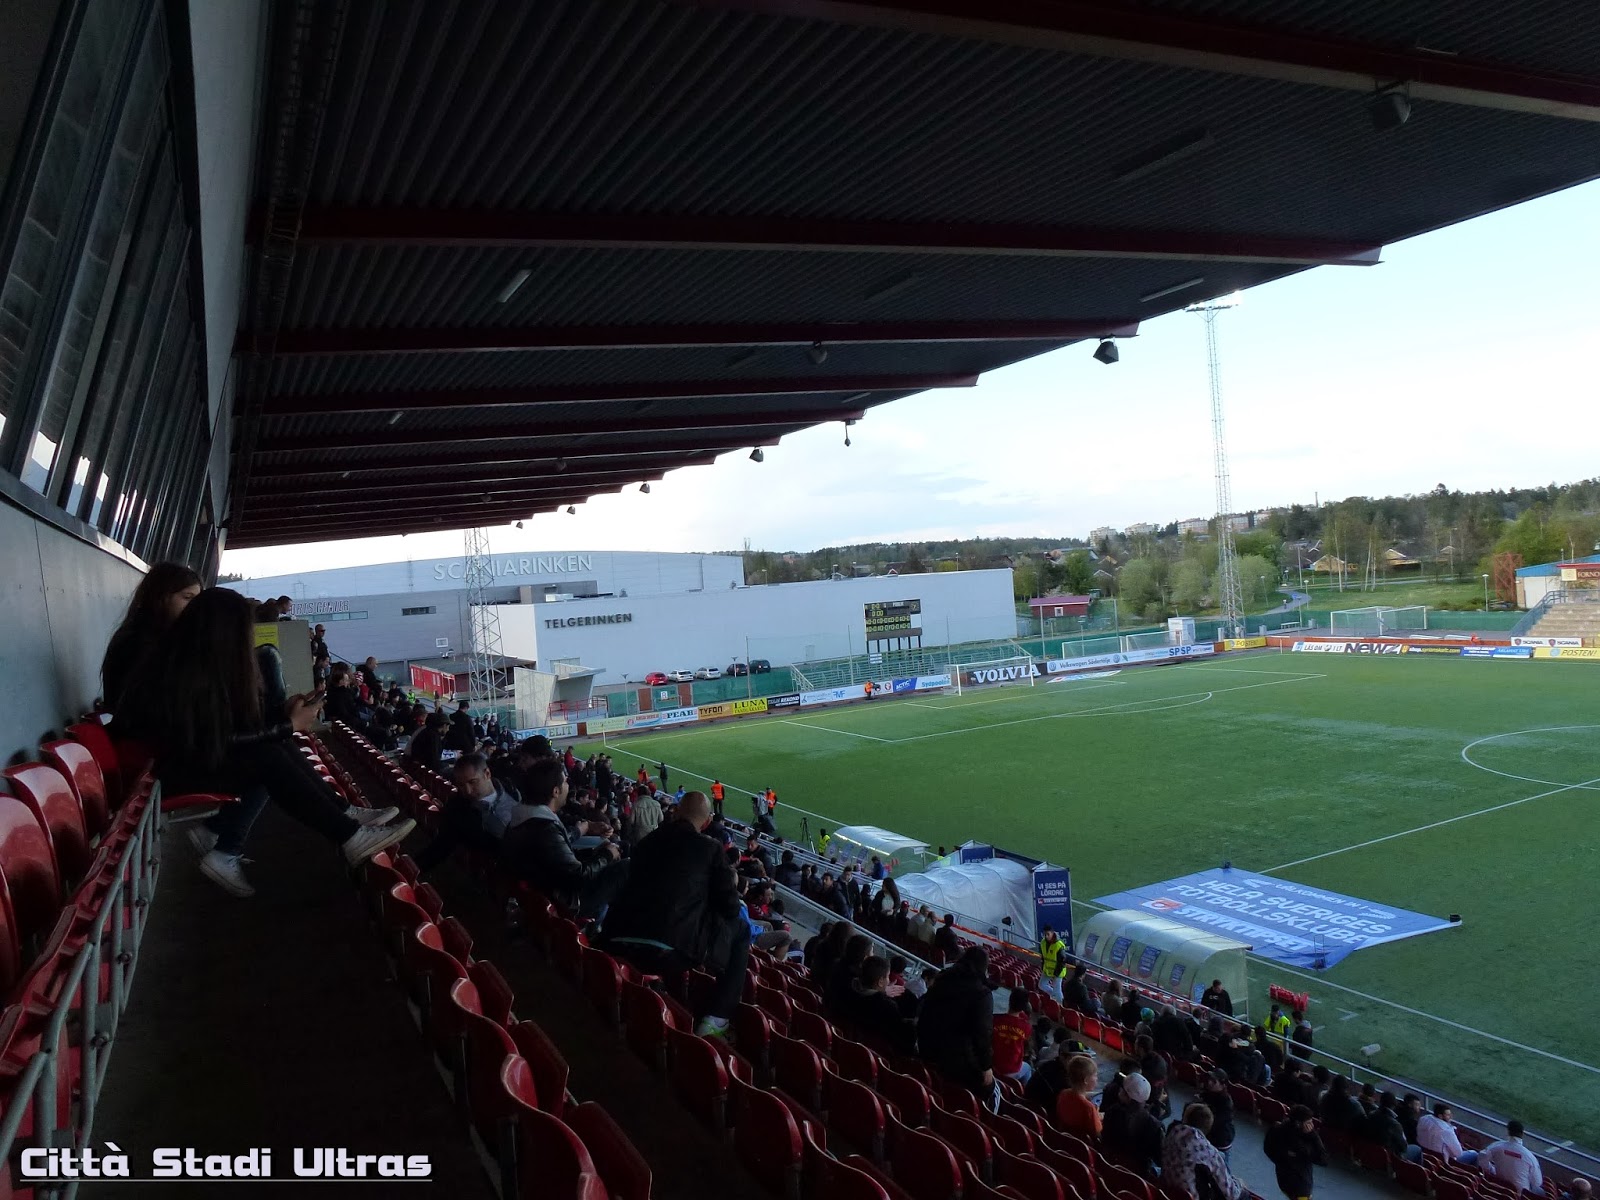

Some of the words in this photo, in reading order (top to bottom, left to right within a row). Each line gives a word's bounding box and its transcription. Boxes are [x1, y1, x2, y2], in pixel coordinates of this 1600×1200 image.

[434, 554, 593, 580] SCANIARINKEN
[316, 600, 350, 613] CENTER
[545, 613, 632, 629] TELGERINKEN
[1059, 660, 1088, 669] Volkswagen
[974, 664, 1041, 684] VOLVIA
[700, 705, 723, 715] TYFON
[734, 698, 766, 709] LUNA
[549, 726, 573, 736] ELIT
[1198, 880, 1264, 900] HELA
[1260, 896, 1392, 934] SVERIGES
